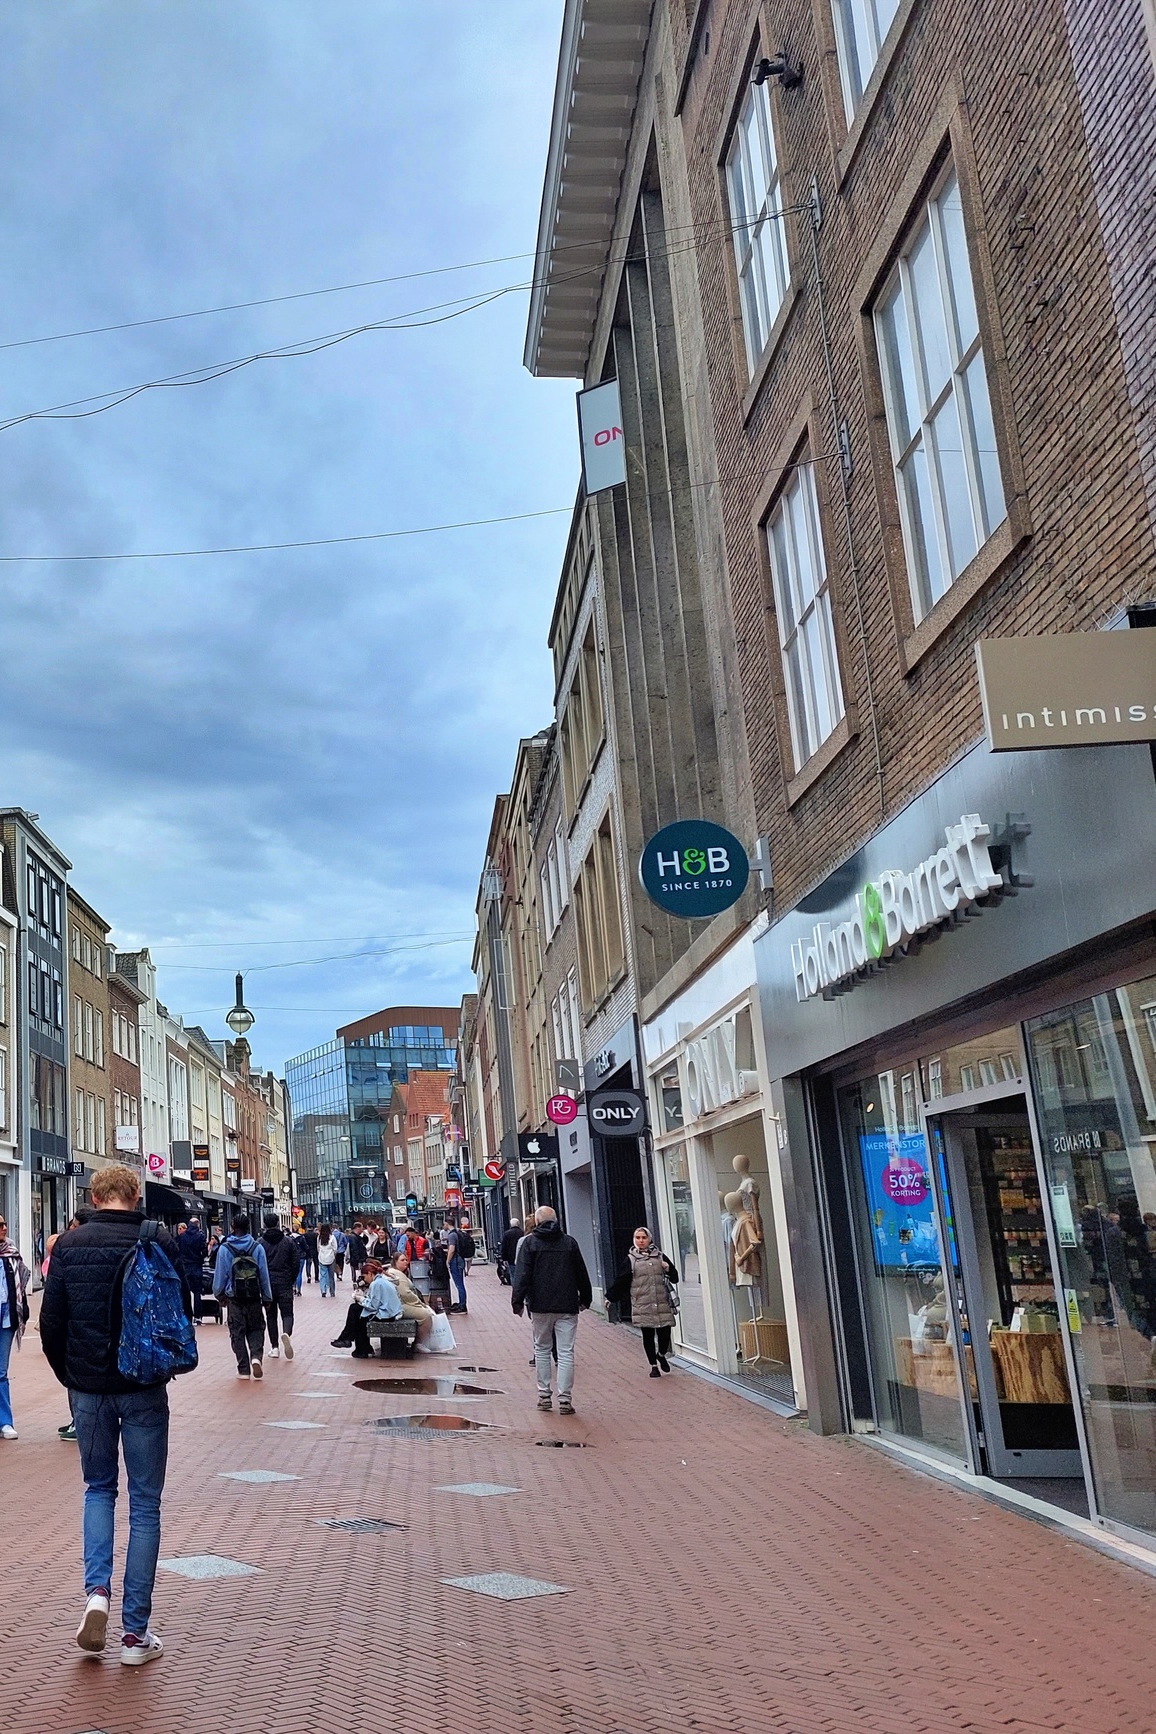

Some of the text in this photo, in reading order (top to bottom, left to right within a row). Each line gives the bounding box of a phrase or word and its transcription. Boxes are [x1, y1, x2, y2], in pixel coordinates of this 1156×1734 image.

[1001, 705, 1156, 730] intimis
[656, 845, 731, 877] H&B
[661, 878, 733, 892] SINCE 1870
[592, 1107, 641, 1120] ONLY
[889, 1173, 921, 1189] 50%
[890, 1189, 921, 1197] KORTING
